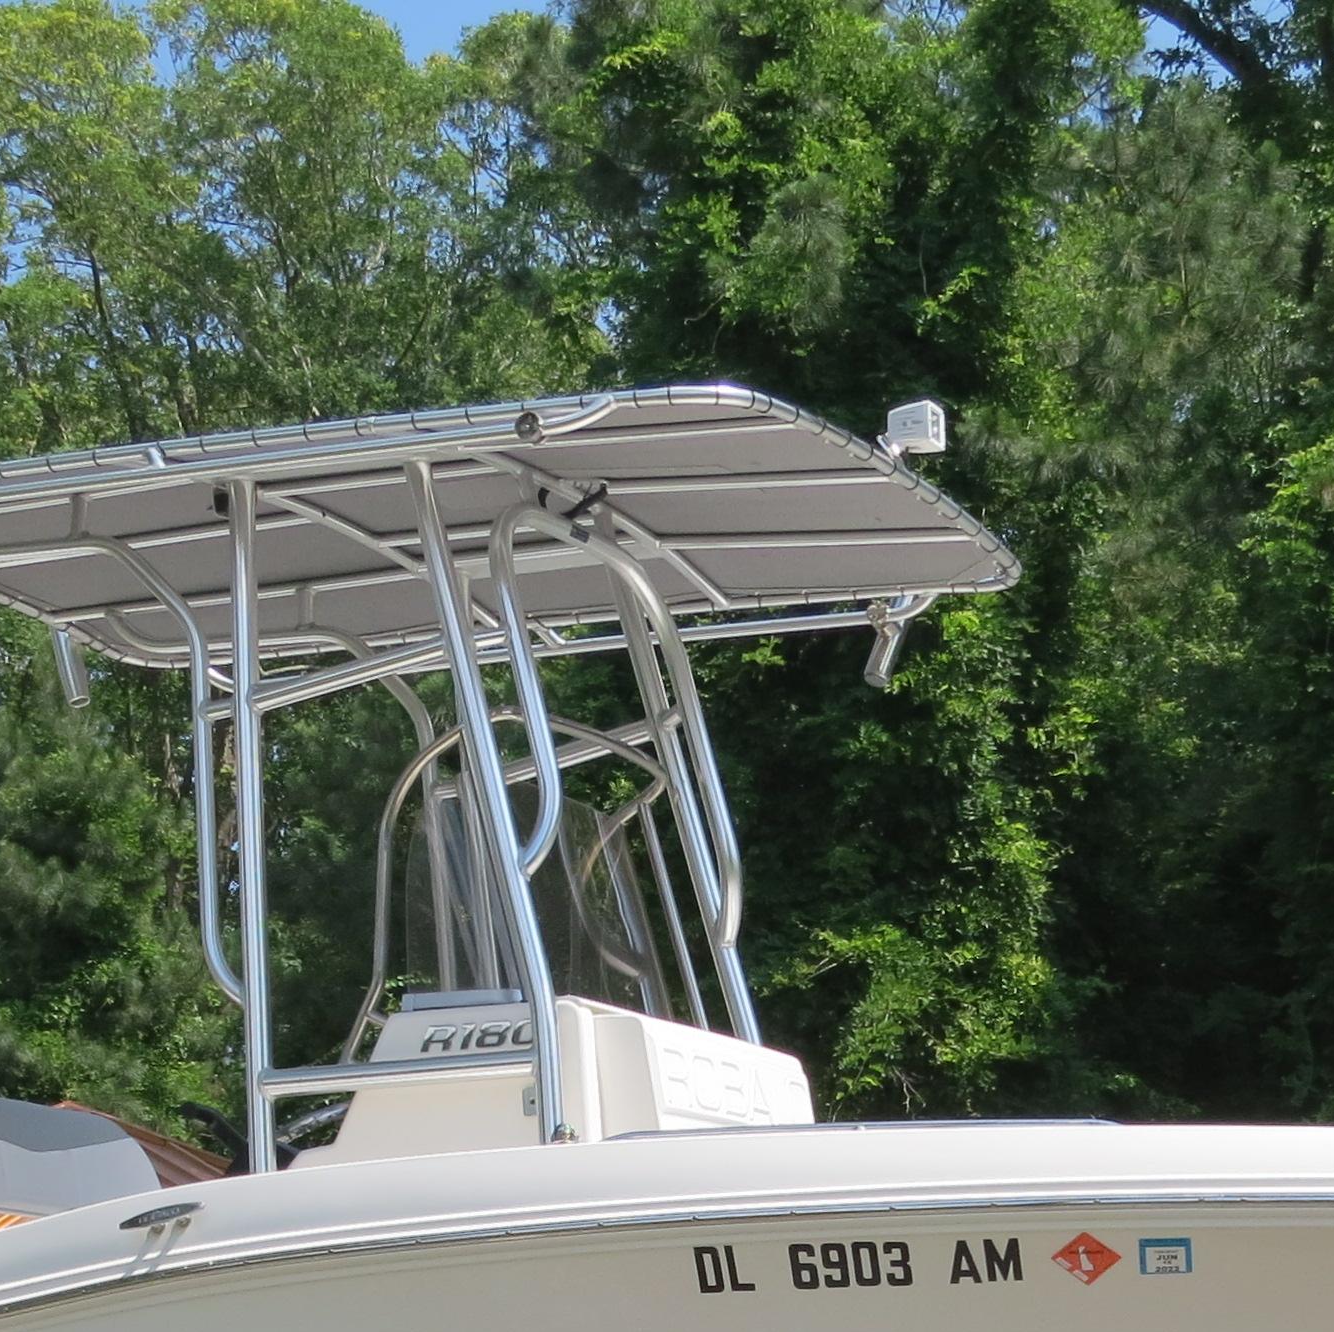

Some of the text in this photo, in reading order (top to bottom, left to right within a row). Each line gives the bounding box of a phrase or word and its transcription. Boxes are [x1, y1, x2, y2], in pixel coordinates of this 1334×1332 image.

[693, 1238, 1024, 1294] DL 6903 AM
